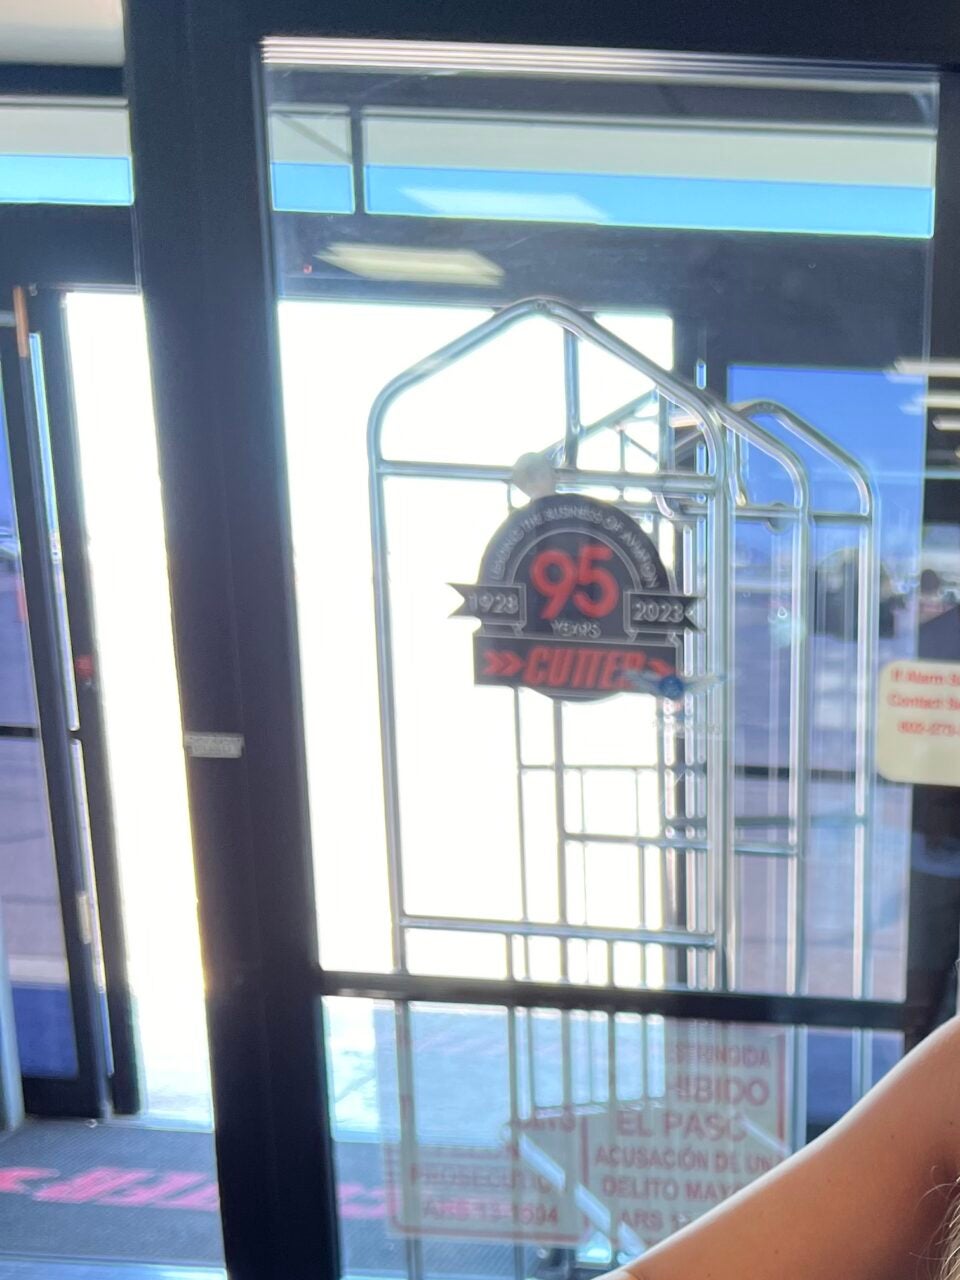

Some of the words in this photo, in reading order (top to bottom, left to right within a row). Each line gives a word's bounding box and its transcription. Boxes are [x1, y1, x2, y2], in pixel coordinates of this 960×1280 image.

[544, 504, 602, 525] BUSINESS
[602, 514, 625, 533] OF
[619, 531, 661, 589] AVIATION
[529, 543, 619, 620] 95
[633, 602, 684, 624] 2023
[551, 619, 602, 638] YEARS
[906, 669, 945, 687] Alarm
[887, 691, 944, 709] Contact
[616, 1110, 652, 1137] EL
[594, 1143, 709, 1171] ACUSACIÓN
[714, 1150, 740, 1174] DE
[601, 1174, 680, 1201] DELITO
[685, 1177, 744, 1203] MAY
